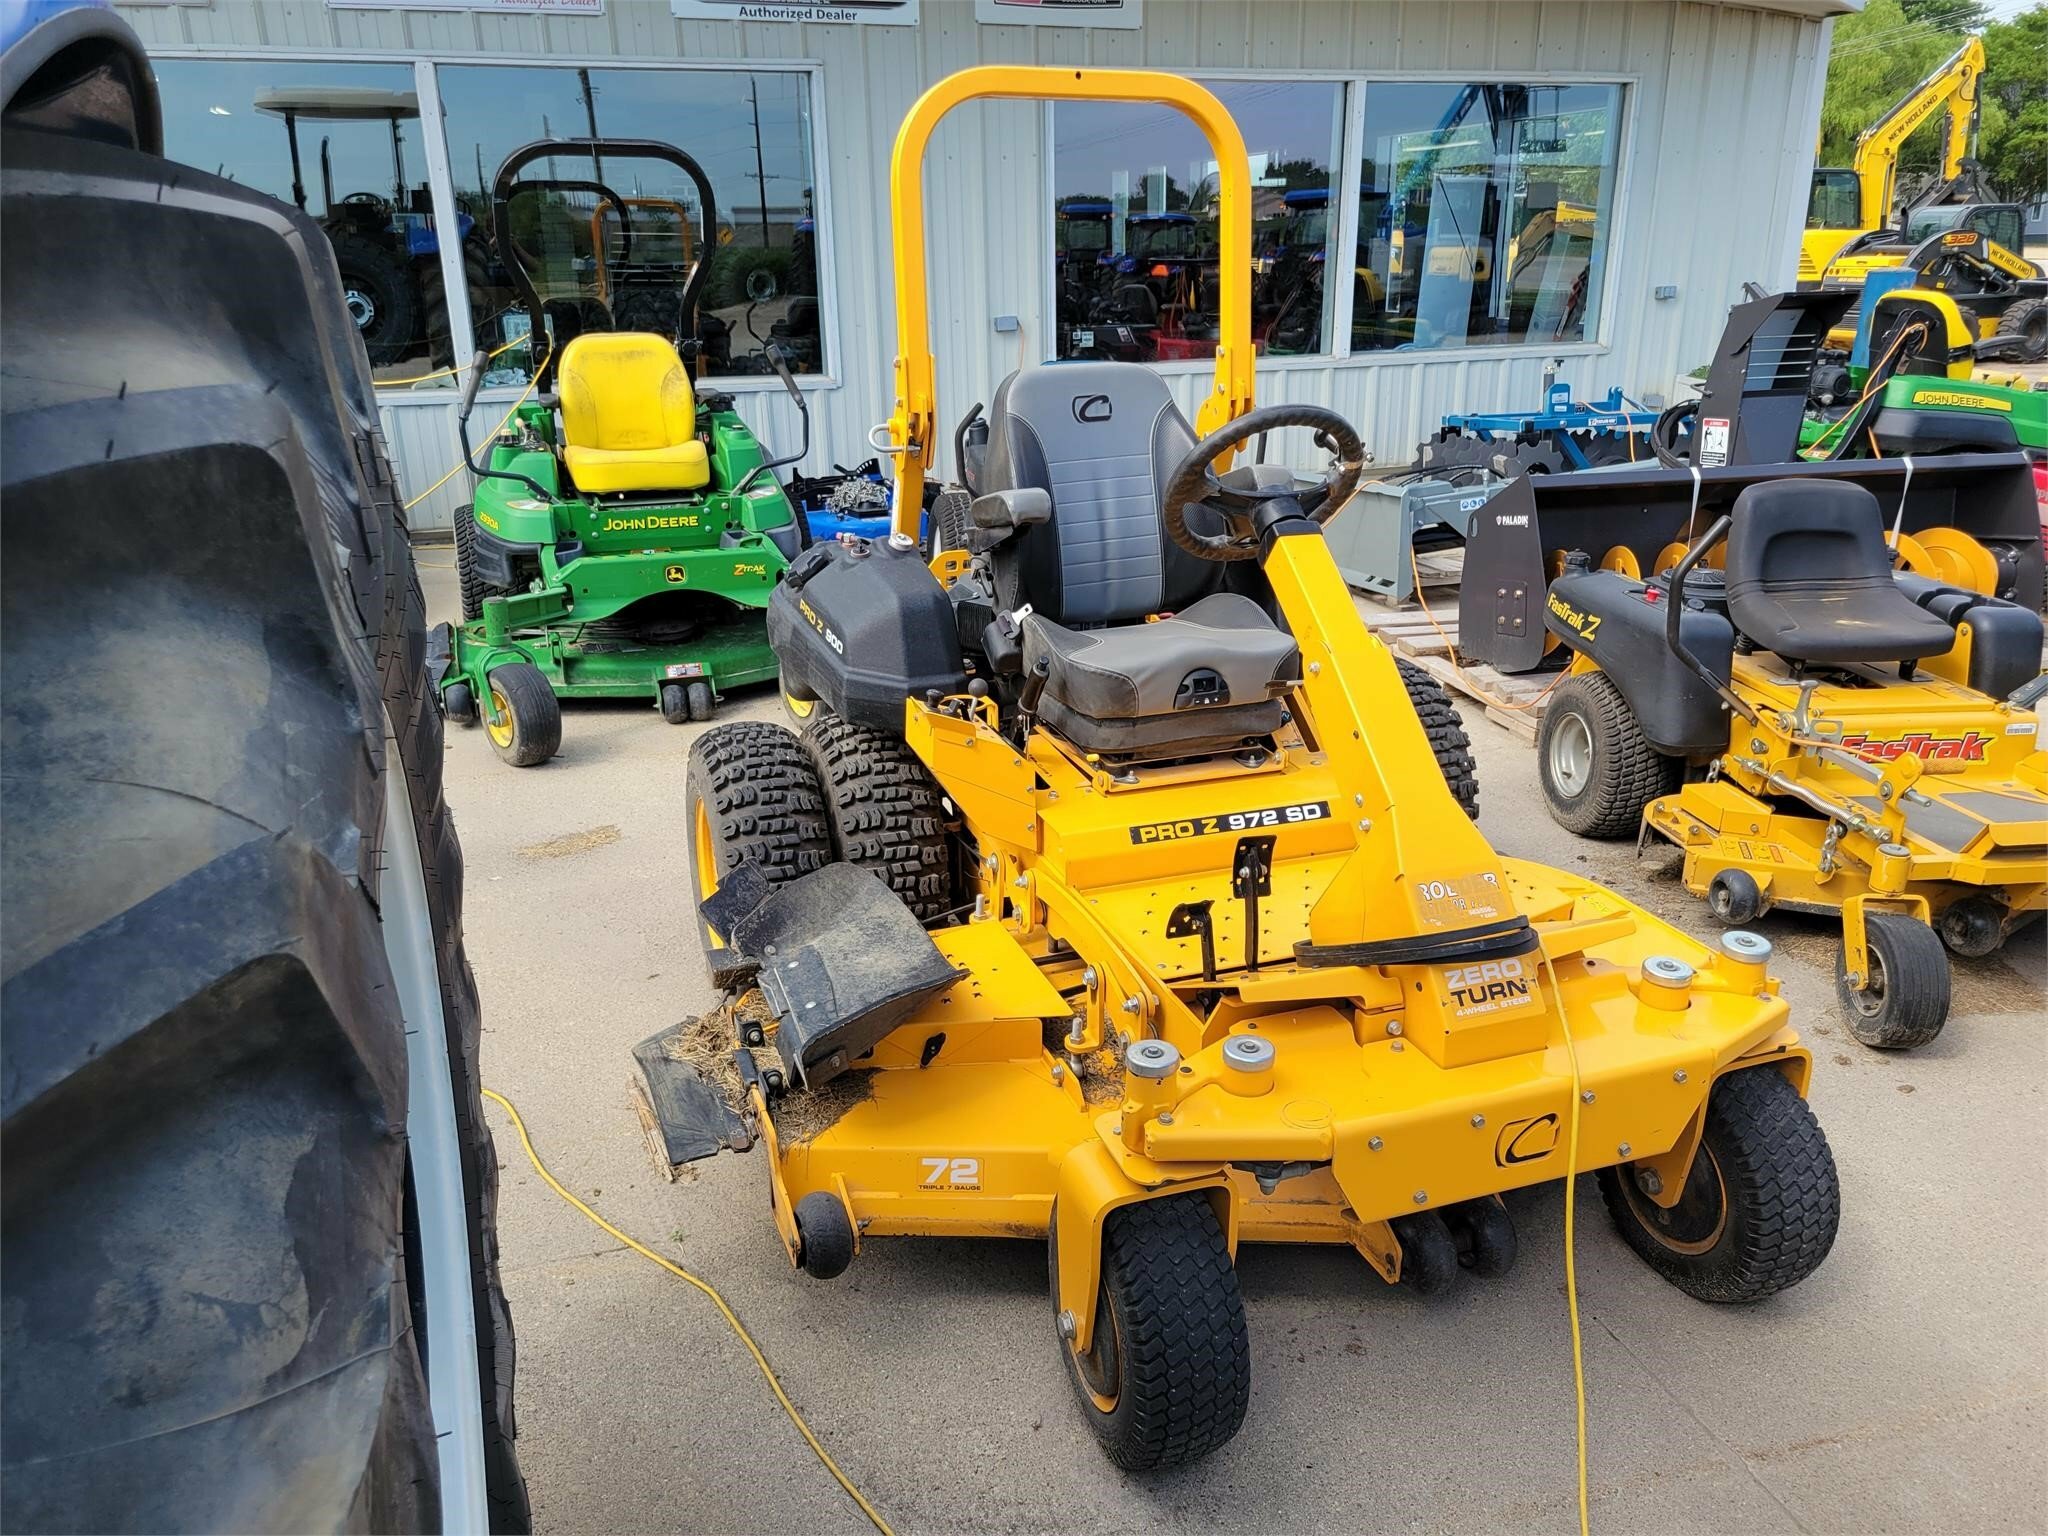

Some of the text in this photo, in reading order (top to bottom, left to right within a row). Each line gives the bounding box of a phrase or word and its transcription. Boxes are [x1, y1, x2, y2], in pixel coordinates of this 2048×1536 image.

[739, 6, 858, 21] Authorized Dealer
[1888, 94, 1938, 142] NEW HOLLAND
[2004, 255, 2030, 276] HOLLAND
[1920, 392, 1985, 407] JOHN DEERE
[603, 515, 699, 531] JOHN DEERE
[799, 598, 844, 655] PRO Z 900
[1547, 592, 1601, 642] FasTrak Z
[1841, 731, 1995, 764] FasTrak
[1139, 804, 1322, 843] PRO Z 972 SD
[1444, 958, 1522, 990] ZERO
[1450, 977, 1528, 1007] TURN
[1456, 996, 1531, 1017] 4-WHEEL STEER
[921, 1157, 979, 1184] 72
